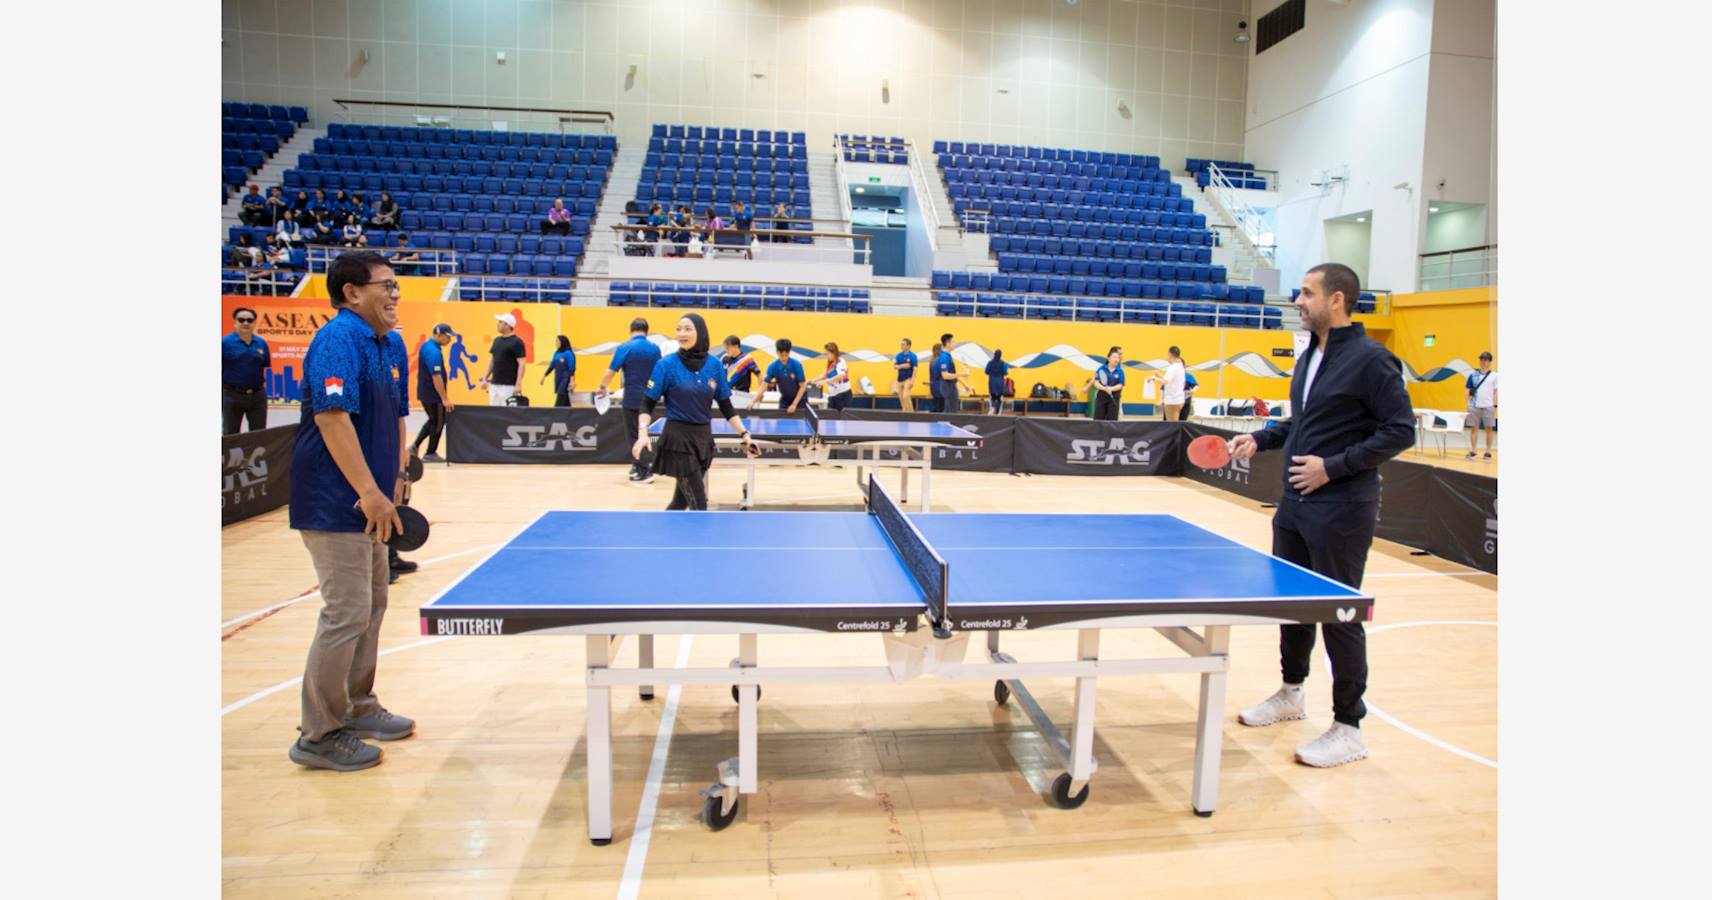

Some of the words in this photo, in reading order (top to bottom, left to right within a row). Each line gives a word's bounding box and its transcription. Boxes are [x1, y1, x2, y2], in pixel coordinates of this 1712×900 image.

[502, 422, 598, 451] STAG
[1066, 438, 1150, 465] STAG
[222, 447, 268, 492] AG
[1202, 468, 1249, 484] OBAL
[222, 484, 267, 508] BAL
[437, 618, 504, 634] BUTTERFLY
[837, 621, 879, 630] Centrefold
[880, 621, 890, 630] 25
[961, 620, 1001, 629] Centrefold
[1002, 620, 1012, 629] 25
